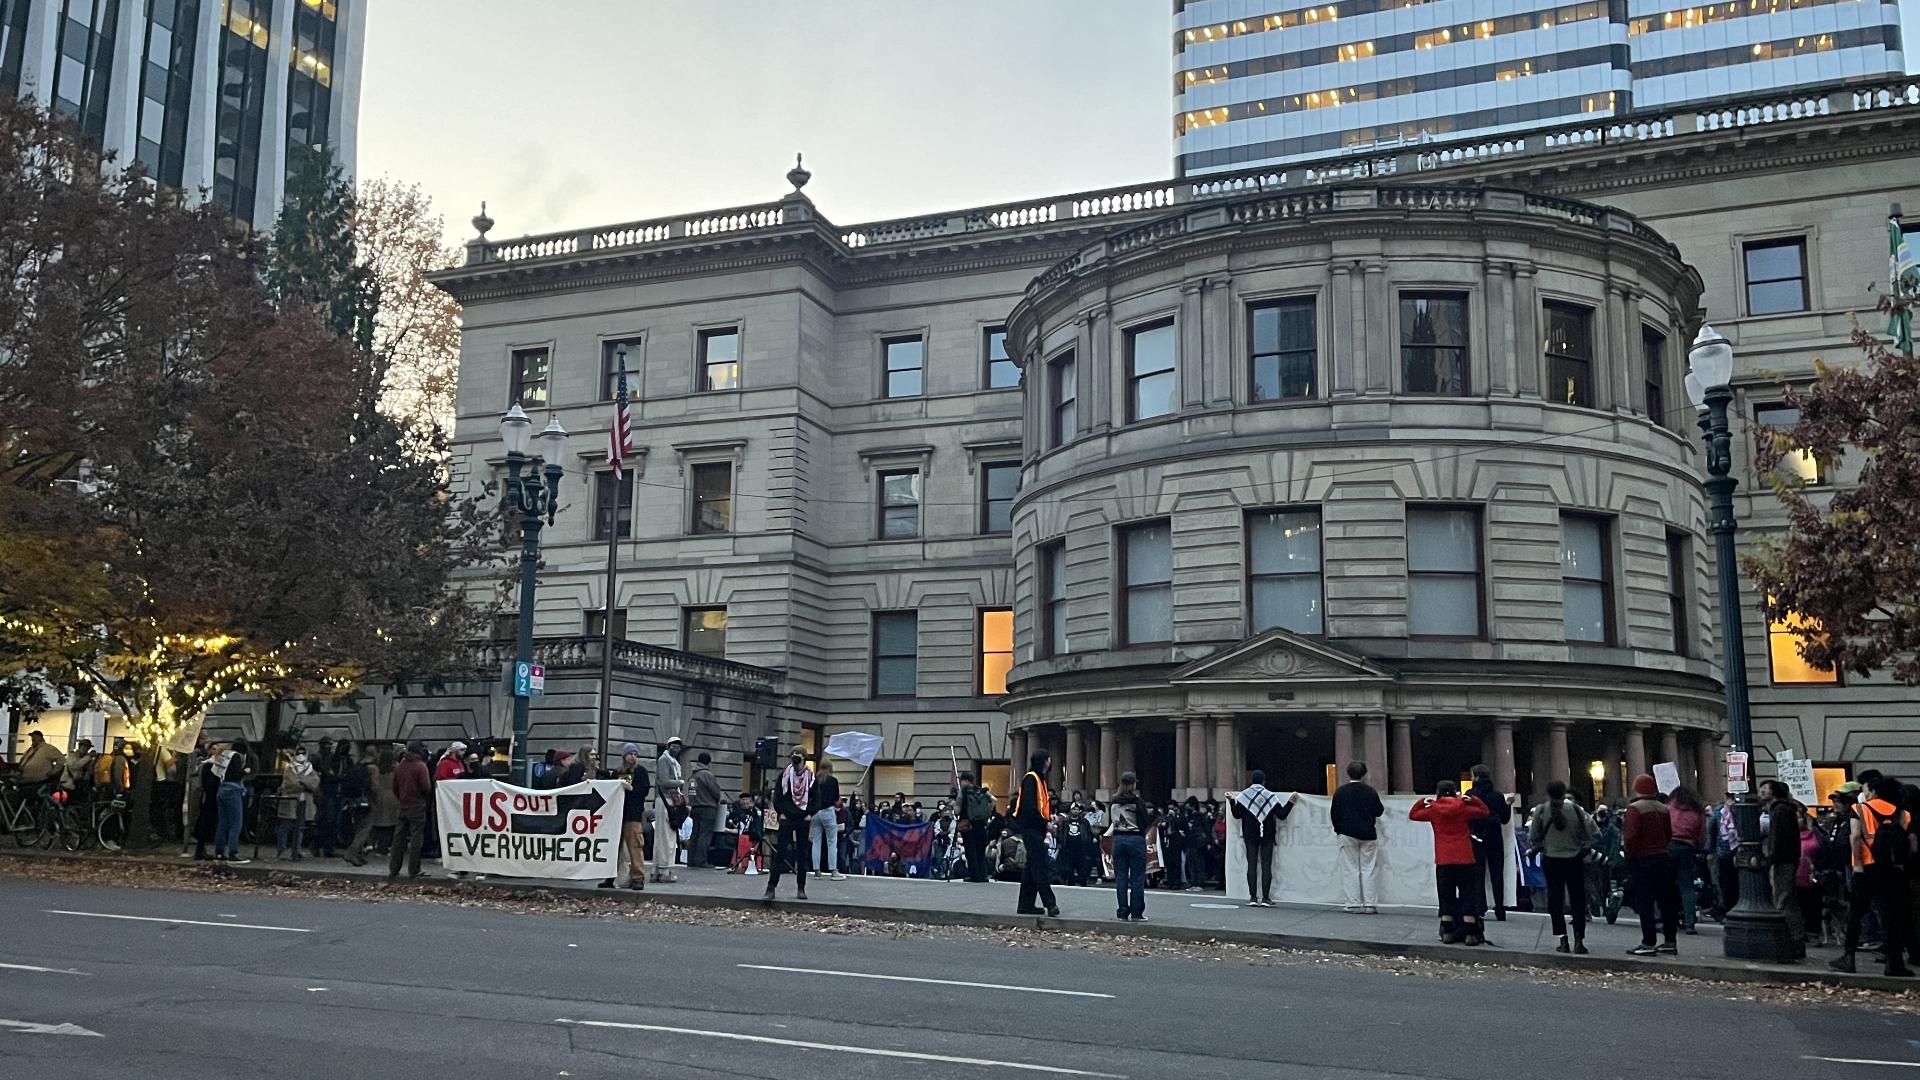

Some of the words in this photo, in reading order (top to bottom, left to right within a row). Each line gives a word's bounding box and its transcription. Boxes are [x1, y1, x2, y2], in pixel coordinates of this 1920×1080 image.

[519, 679, 527, 691] 2
[462, 791, 510, 833] U.S.
[513, 793, 554, 812] OUT
[571, 814, 604, 834] OF
[447, 832, 609, 863] EVERYWHERE
